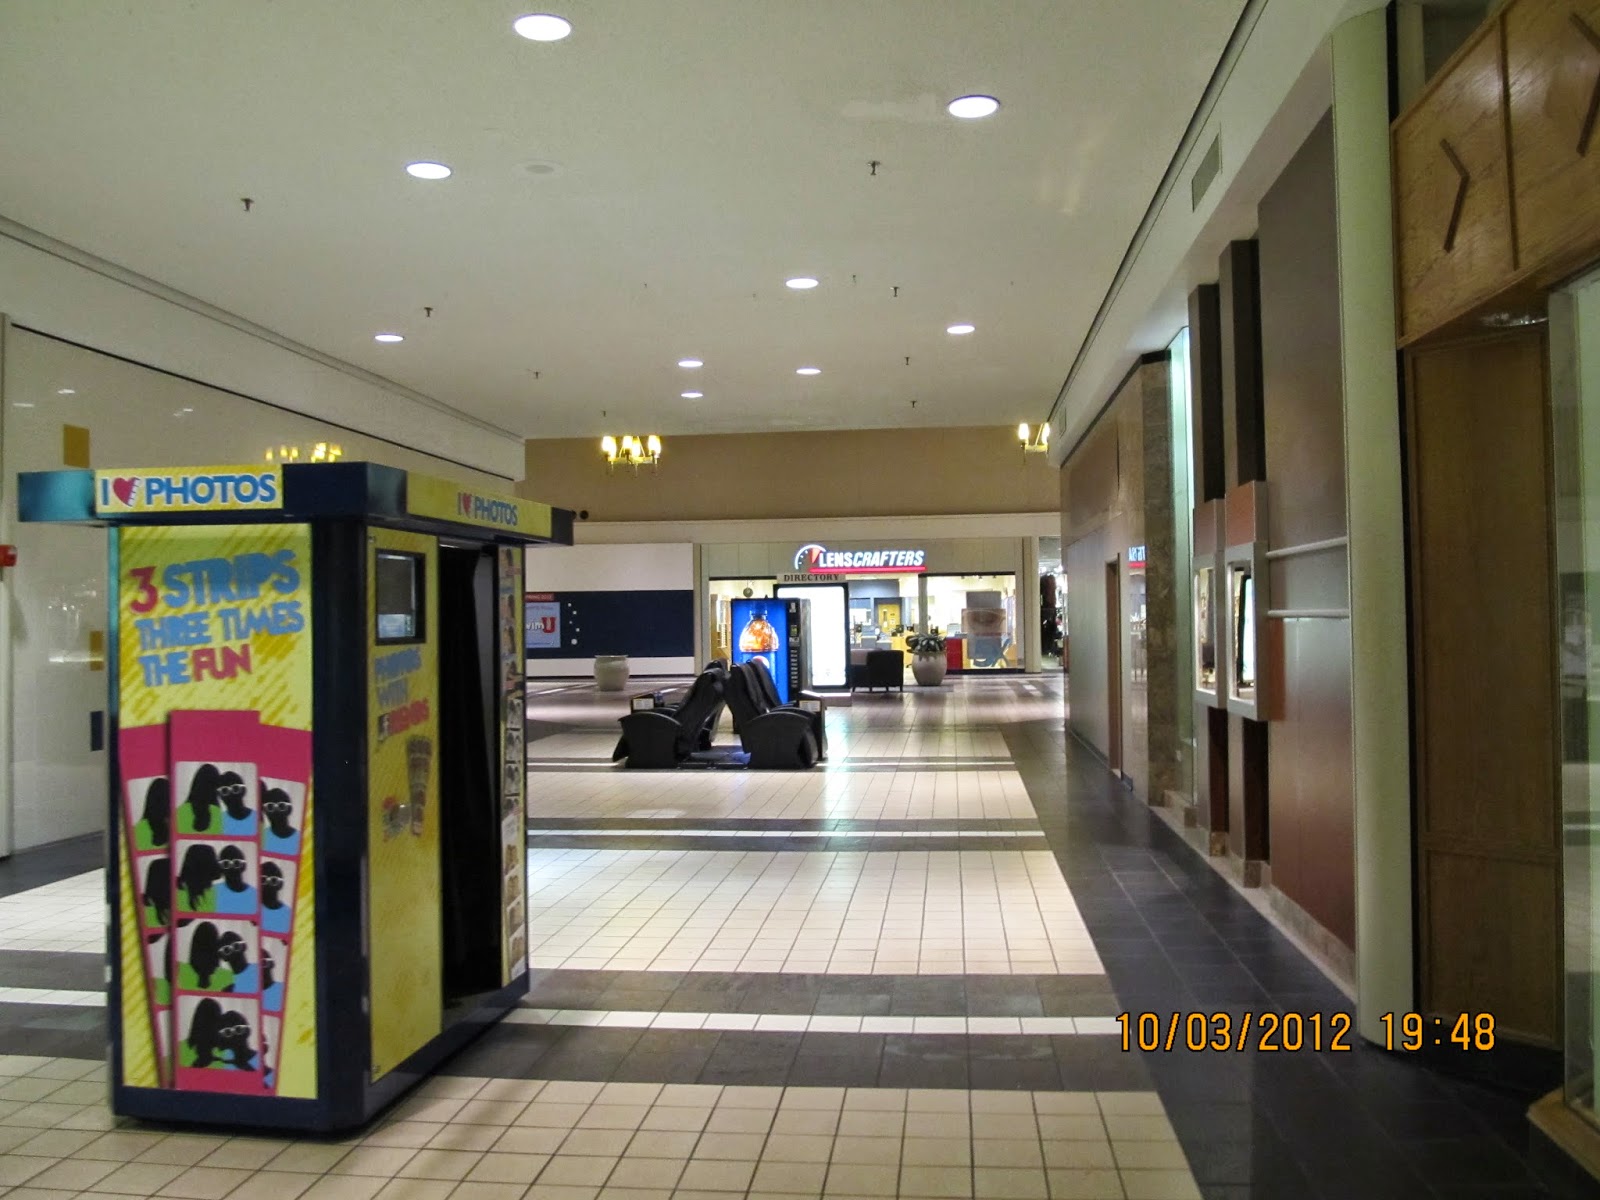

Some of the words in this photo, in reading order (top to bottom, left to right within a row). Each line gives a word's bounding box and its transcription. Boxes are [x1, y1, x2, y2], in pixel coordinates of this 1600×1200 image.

[101, 478, 109, 506] I
[145, 473, 277, 505] PHOTOS
[474, 495, 518, 526] PHOTOS
[818, 550, 925, 568] LENSCRAFTERS
[129, 565, 159, 613] 3
[163, 549, 300, 609] STRIPS
[783, 573, 840, 582] DIRECTORY
[135, 610, 213, 651] THREE
[218, 600, 305, 641] TIMES
[138, 651, 192, 687] THE
[191, 643, 252, 682] FUN
